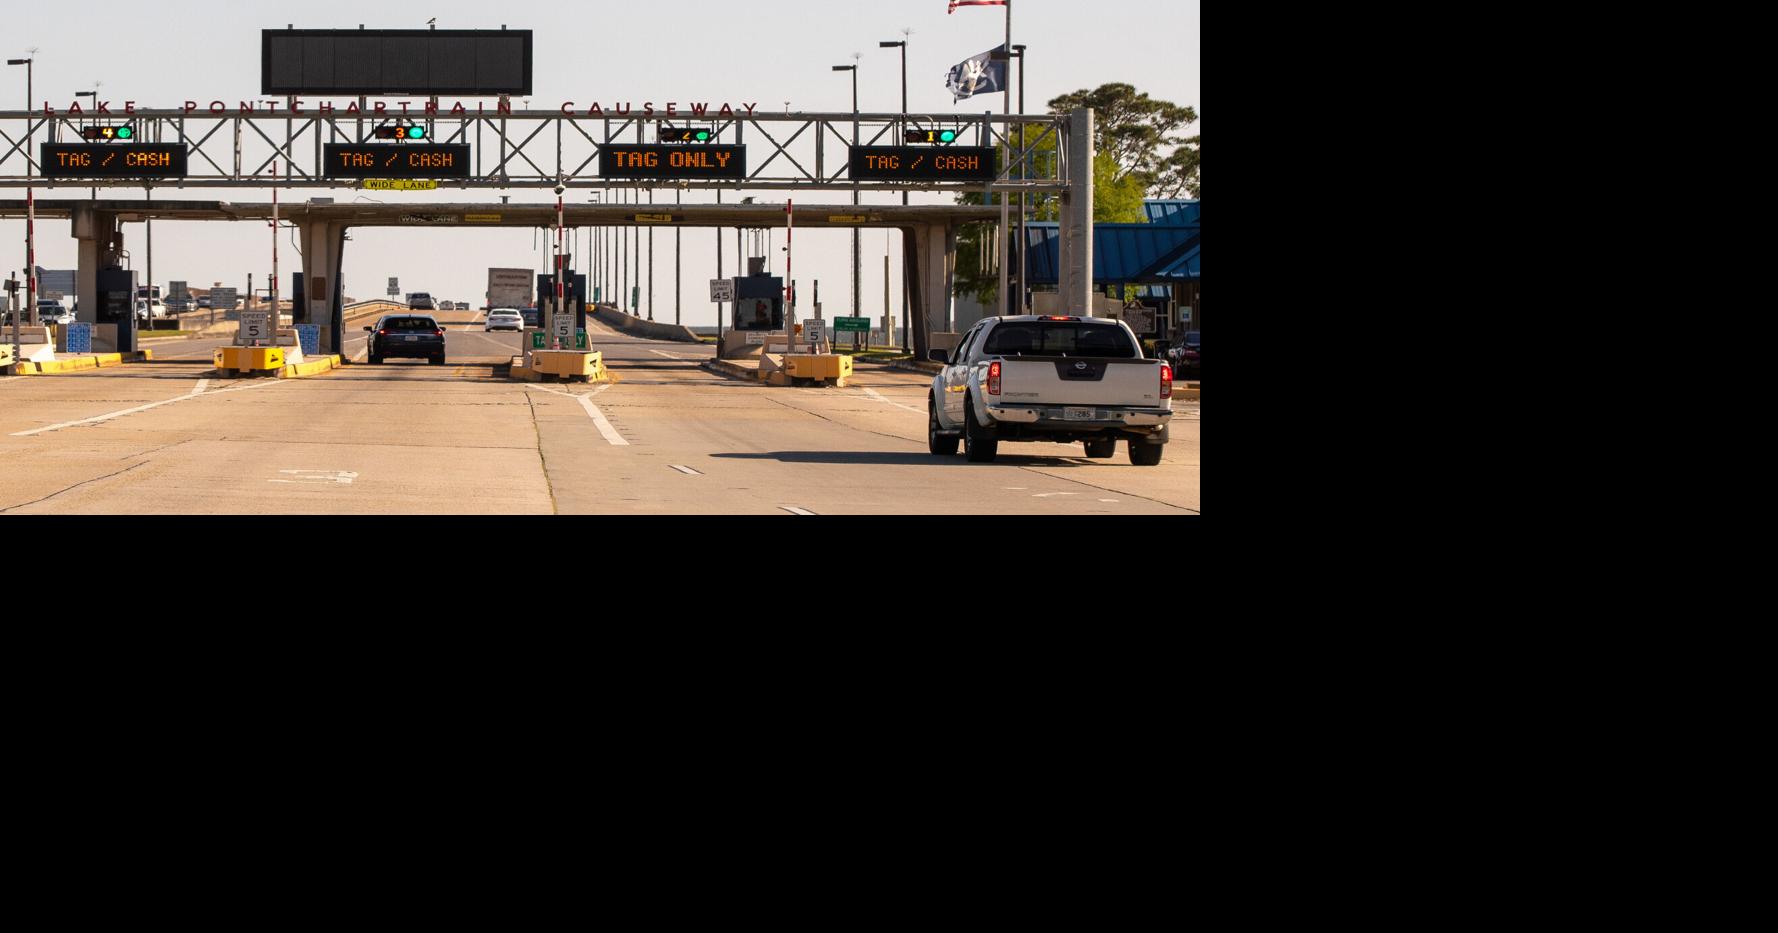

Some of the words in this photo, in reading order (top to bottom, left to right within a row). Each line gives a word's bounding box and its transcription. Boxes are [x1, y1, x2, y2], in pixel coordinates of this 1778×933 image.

[44, 101, 136, 115] LAKE
[185, 101, 512, 115] PONTCHARTRAIN
[561, 102, 757, 116] CAUSEWAY
[103, 128, 113, 138] 4
[396, 127, 404, 138] 3
[927, 131, 934, 142] 1
[57, 152, 91, 166] TAG
[126, 152, 170, 166] CASH
[340, 153, 374, 167] TAG
[409, 153, 452, 167] CASH
[614, 151, 658, 167] TAG
[670, 151, 730, 168] ONLY
[865, 155, 899, 169] TAG
[935, 155, 979, 170] CASH
[249, 325, 259, 336] 5
[560, 326, 568, 335] 5
[810, 331, 818, 340] 5
